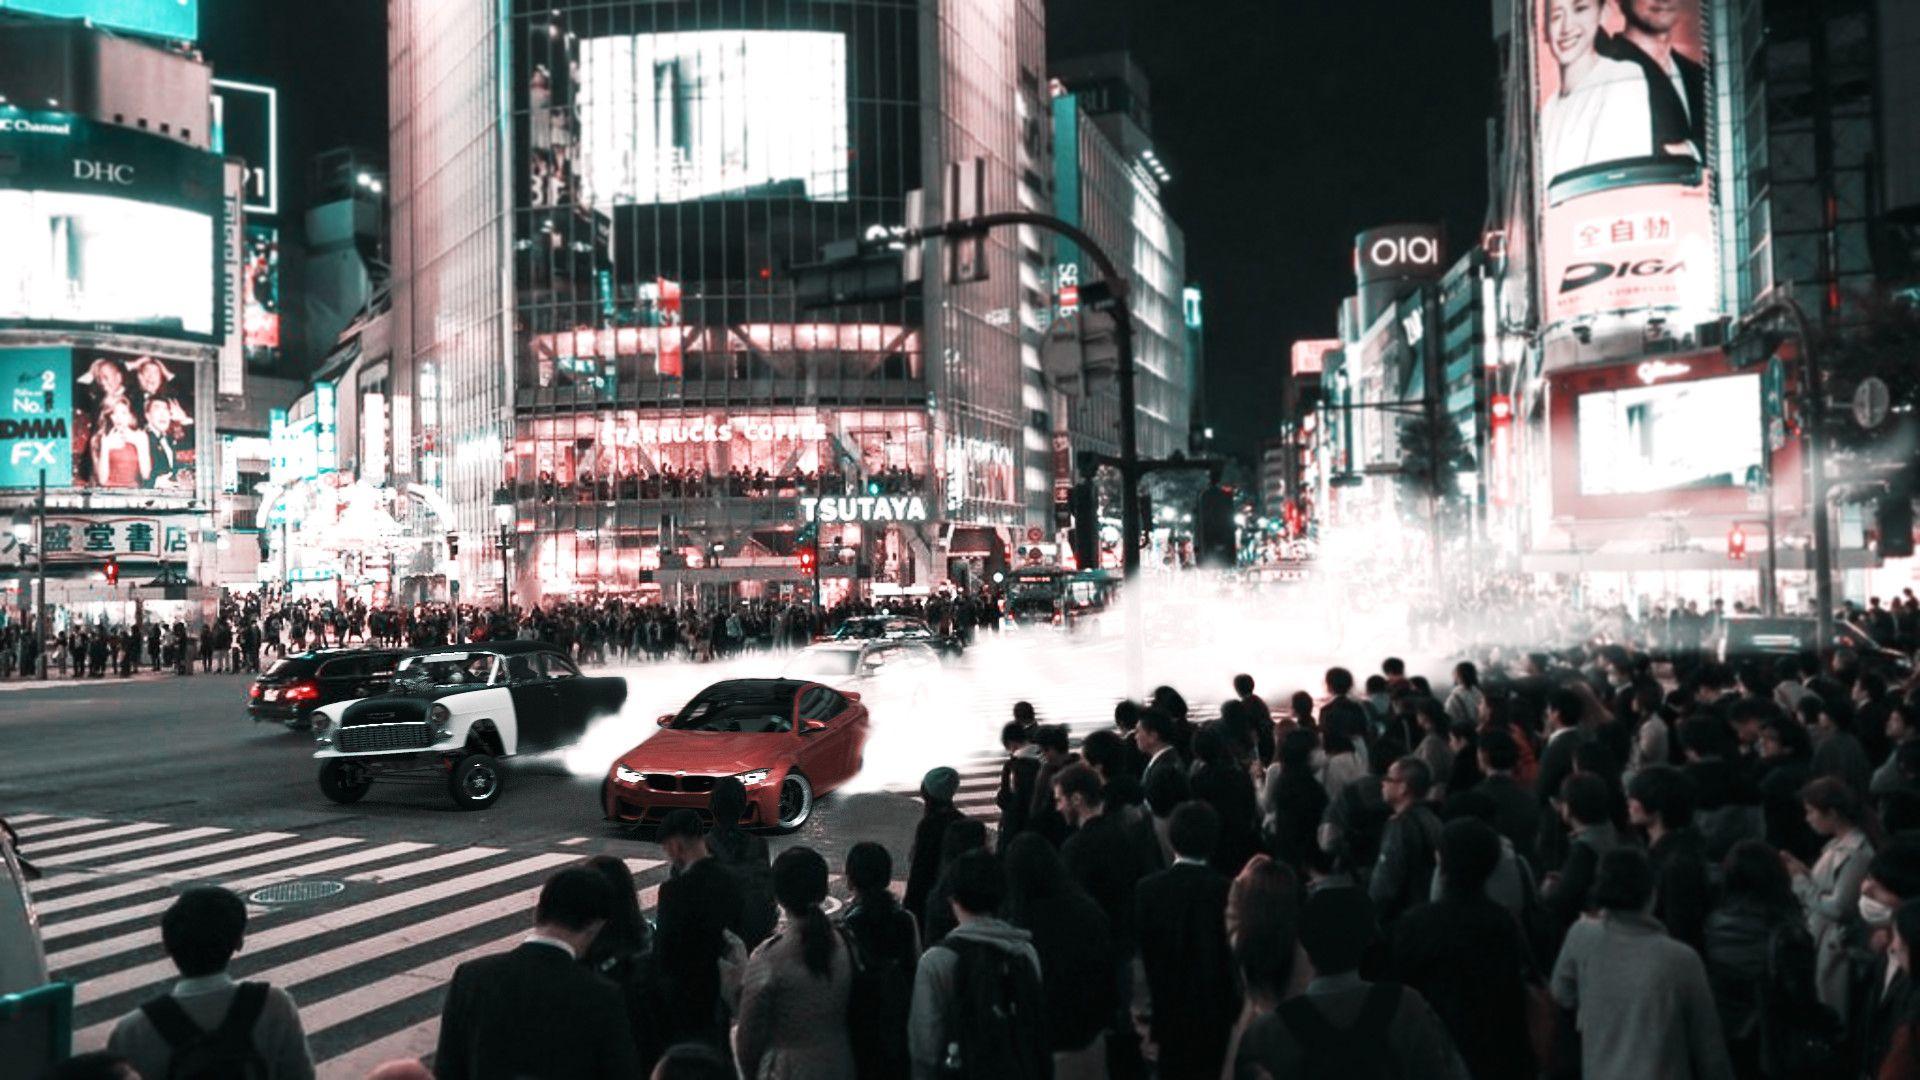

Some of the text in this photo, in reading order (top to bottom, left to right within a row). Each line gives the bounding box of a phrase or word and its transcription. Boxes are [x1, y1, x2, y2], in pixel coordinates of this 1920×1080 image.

[72, 158, 135, 185] DHC
[1578, 215, 1671, 247] 全自動
[0, 418, 67, 439] DMM
[601, 422, 827, 447] STARBUCKS COFFEE
[10, 441, 57, 465] FX
[801, 496, 926, 521] TSUTAYA
